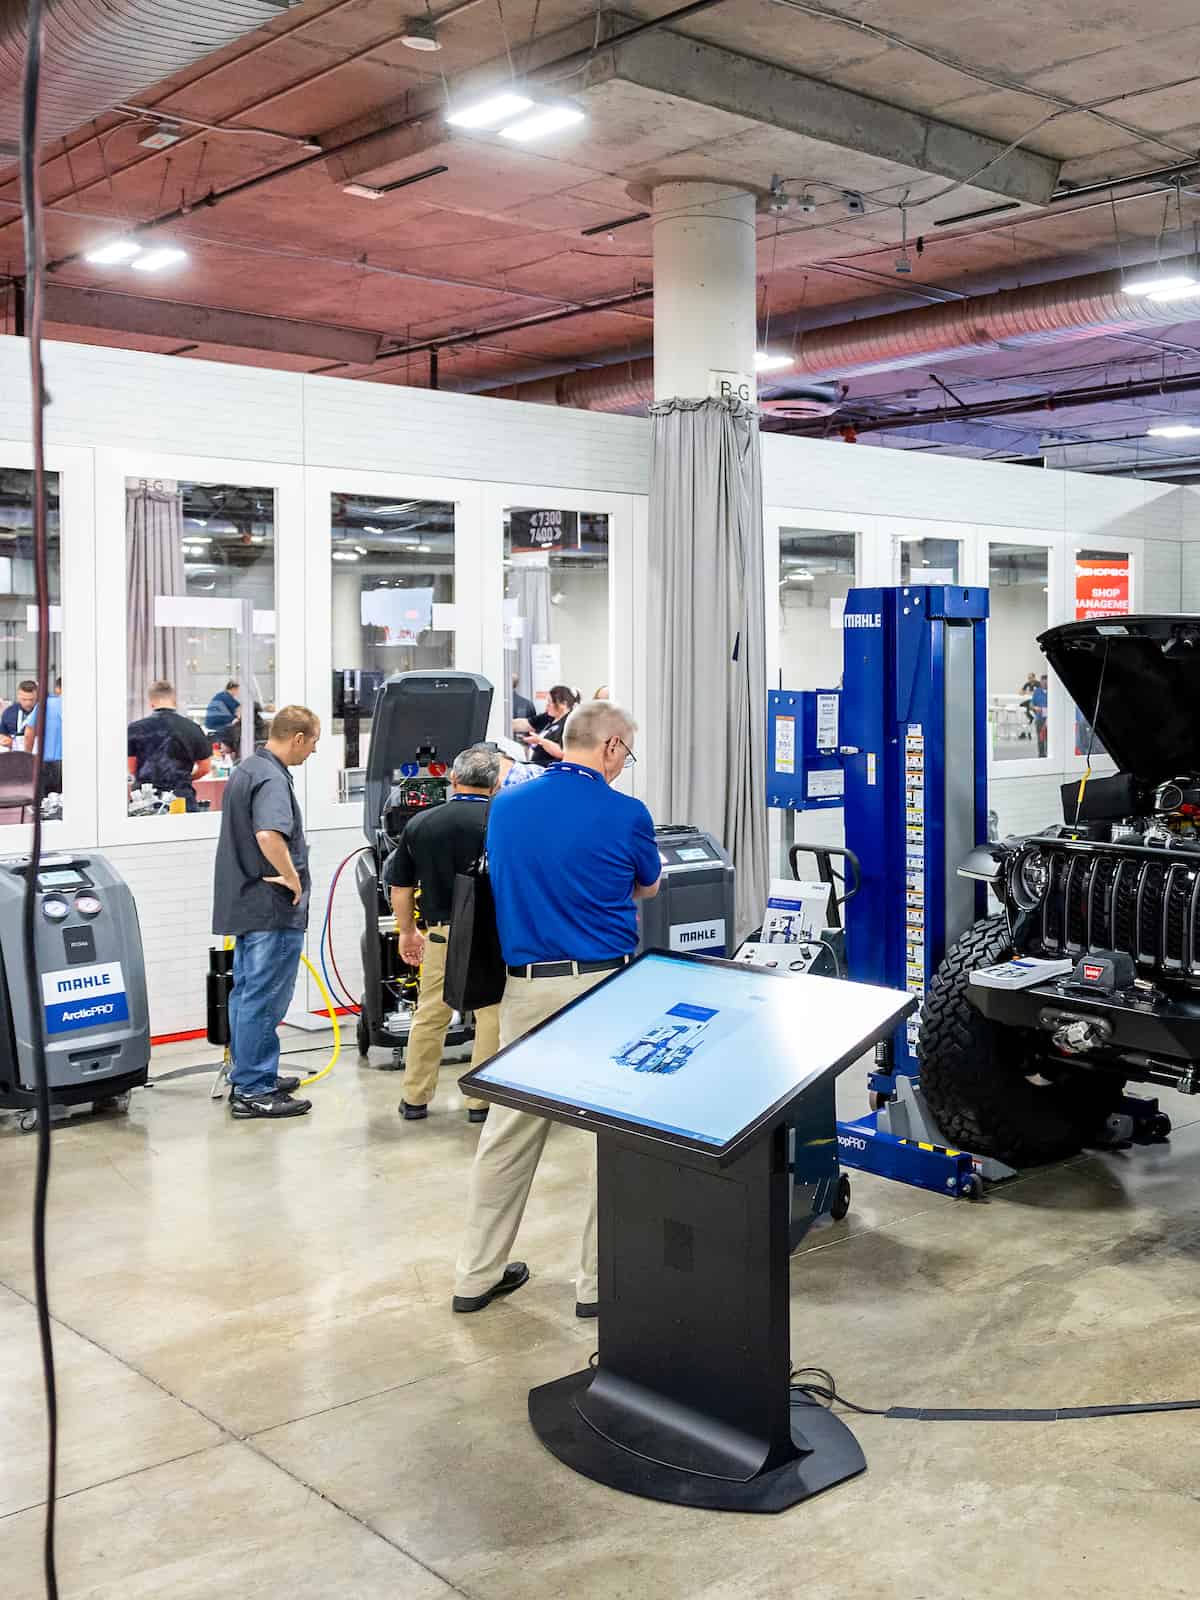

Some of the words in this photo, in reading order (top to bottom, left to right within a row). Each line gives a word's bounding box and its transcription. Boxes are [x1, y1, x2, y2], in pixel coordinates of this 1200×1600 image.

[1091, 588, 1121, 597] SHOP
[1076, 600, 1128, 609] ANAGEME
[844, 614, 882, 628] MAHLE
[680, 929, 716, 943] MAHLE
[57, 974, 111, 992] MAHLE
[62, 1003, 114, 1022] ArcticPRO
